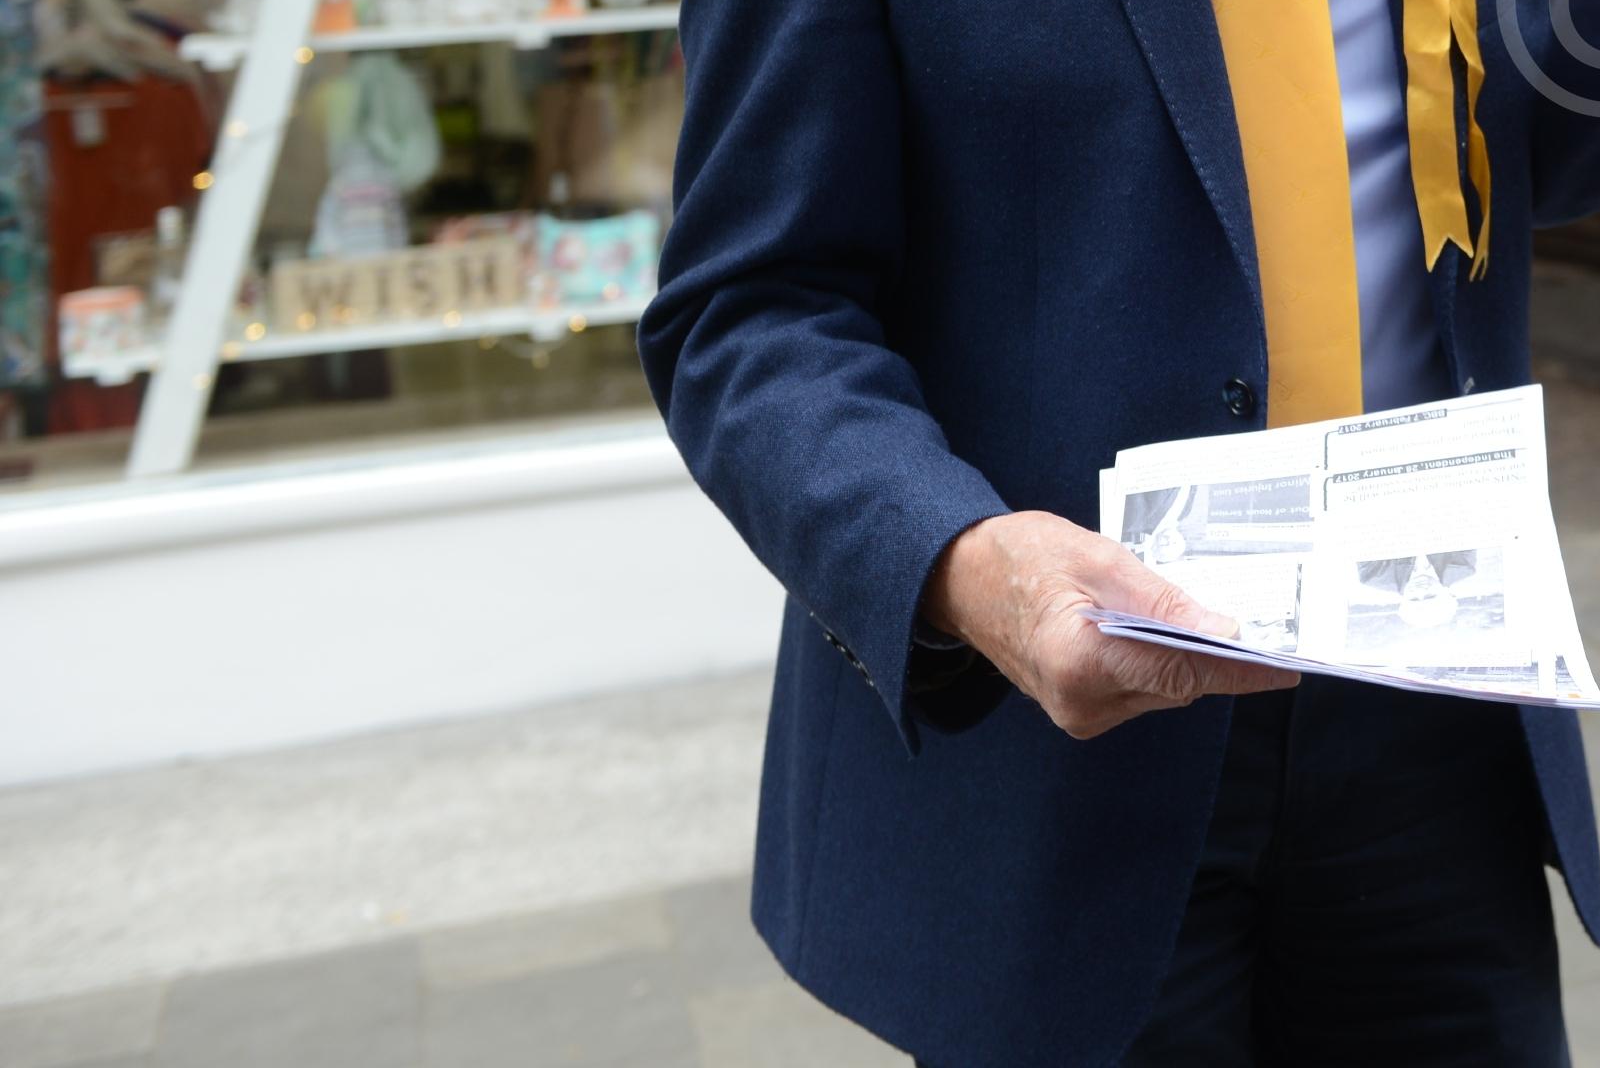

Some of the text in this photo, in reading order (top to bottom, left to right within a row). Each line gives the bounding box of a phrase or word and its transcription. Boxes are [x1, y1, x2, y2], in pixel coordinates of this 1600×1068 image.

[301, 252, 498, 321] WISH
[1364, 415, 1411, 429] February
[1338, 423, 1362, 434] 2017
[1494, 451, 1512, 460] The
[1334, 472, 1359, 483] 2017
[1362, 465, 1402, 479] January
[1235, 482, 1272, 495] Injuries
[1275, 476, 1310, 489] Minor
[1274, 506, 1286, 515] of
[1290, 505, 1309, 514] Out
